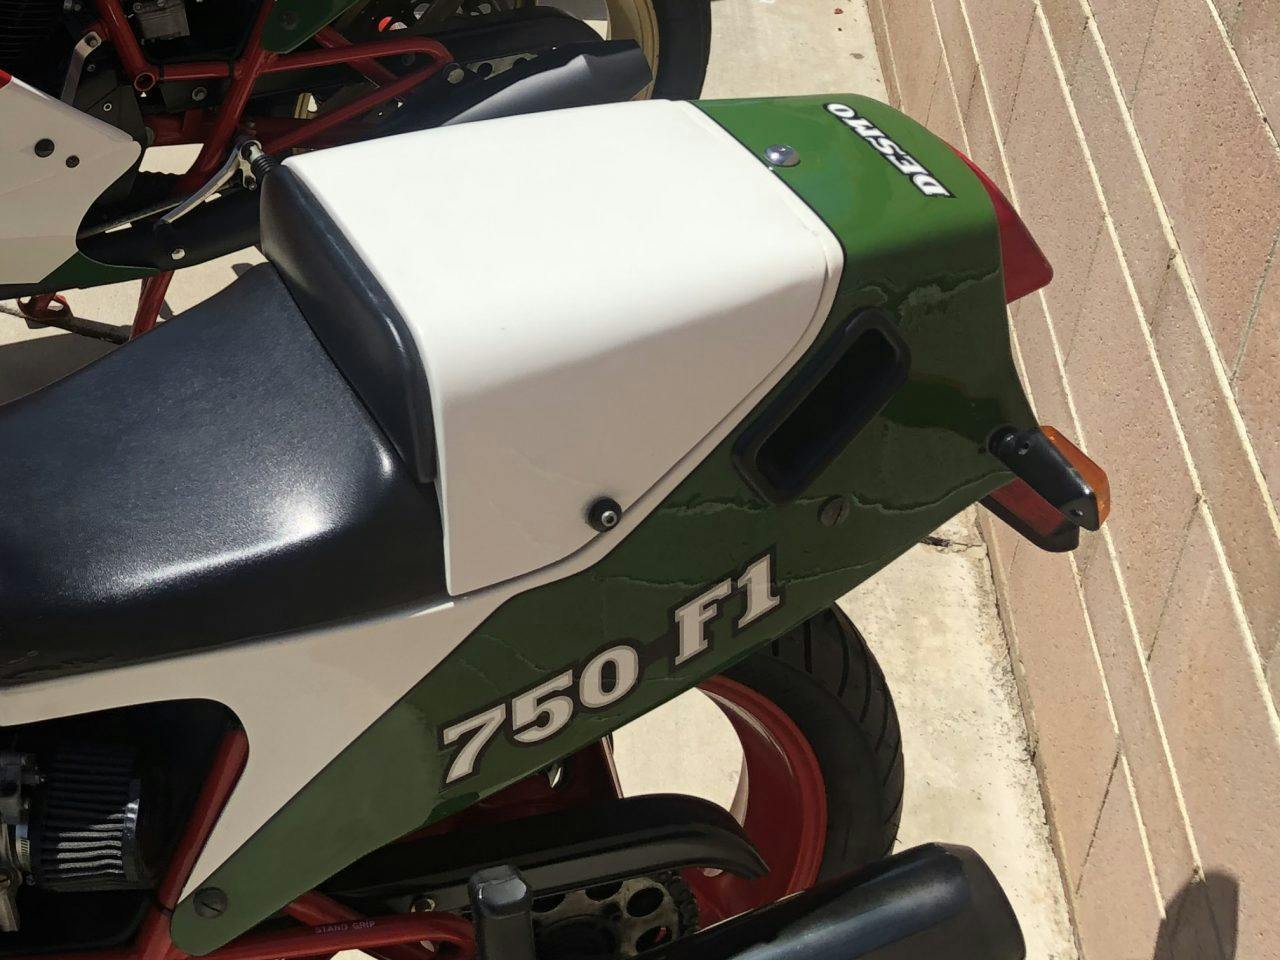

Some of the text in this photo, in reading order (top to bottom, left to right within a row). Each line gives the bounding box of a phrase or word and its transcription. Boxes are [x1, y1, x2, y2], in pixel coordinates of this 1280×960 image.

[827, 103, 950, 196] DESMO
[443, 554, 781, 784] 750 F1
